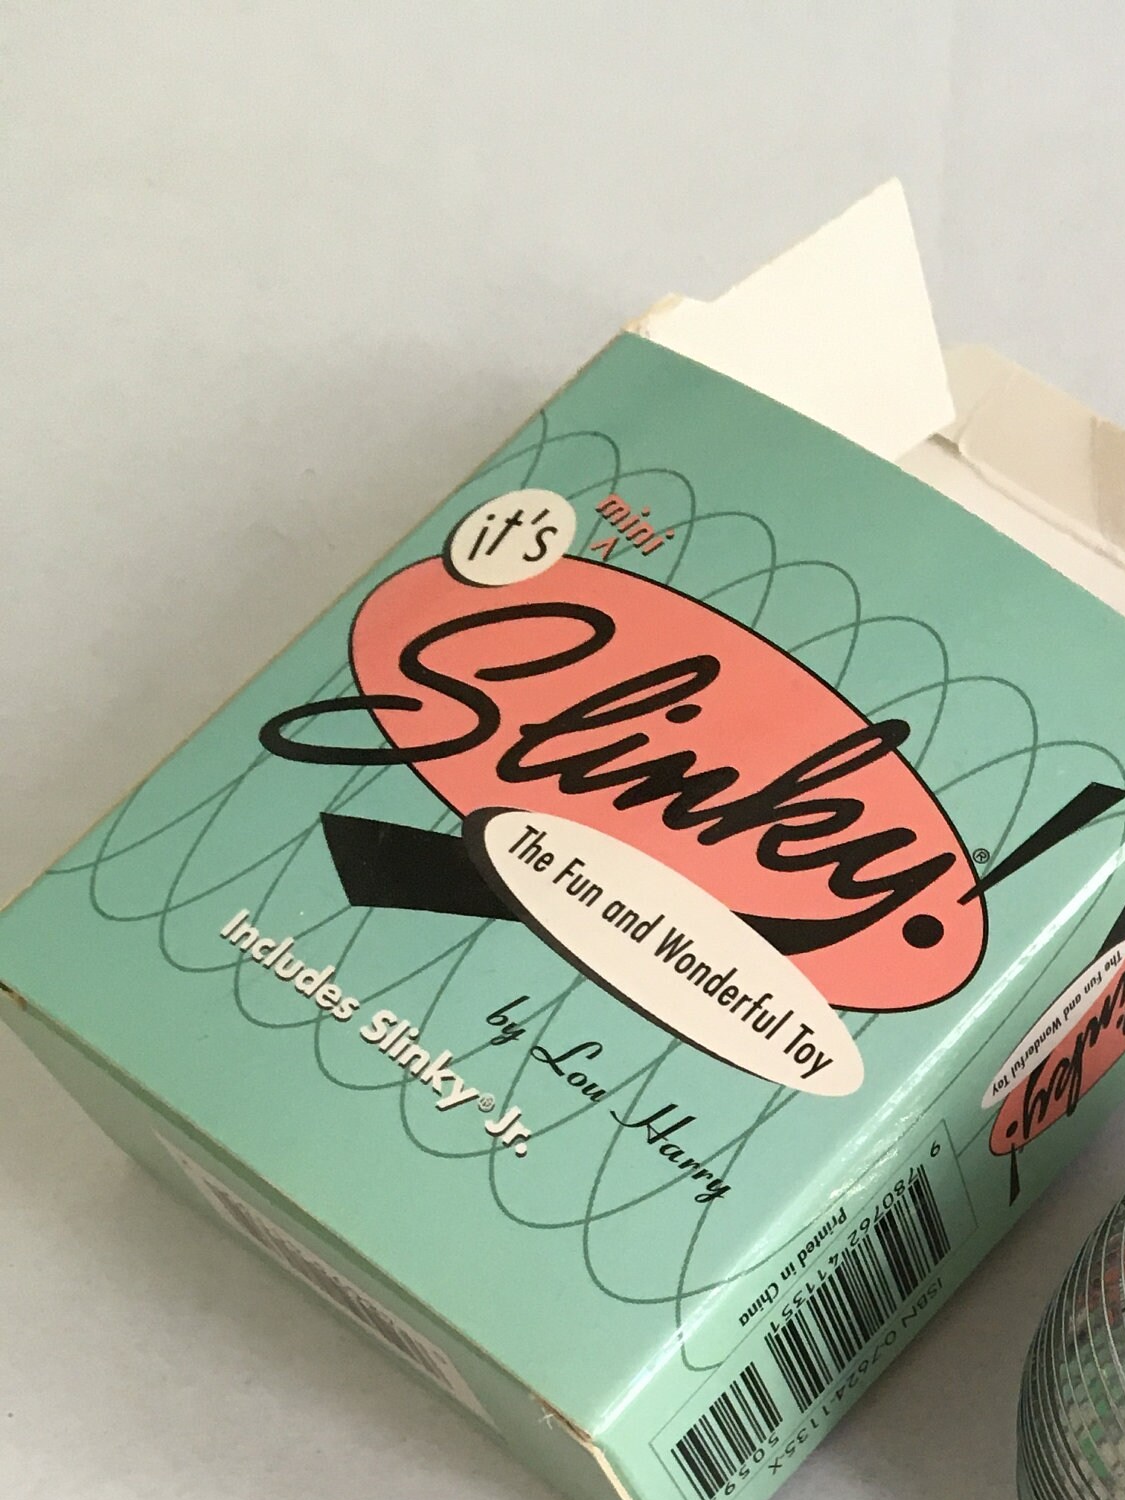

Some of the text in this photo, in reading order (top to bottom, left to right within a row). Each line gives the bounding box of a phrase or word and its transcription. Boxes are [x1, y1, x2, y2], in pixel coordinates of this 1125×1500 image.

[468, 509, 558, 562] it's
[595, 493, 675, 556] mini
[219, 909, 360, 1023] Includes
[485, 1106, 533, 1158] Jr.
[508, 825, 833, 1079] The Fun and Wonderful Toy
[992, 950, 1122, 1096] The Fun and Wonderful Toy
[486, 995, 732, 1203] by Lou Harry
[738, 1206, 847, 1327] Printed in China
[768, 1277, 943, 1475] ISBN 0-7624-1135-X
